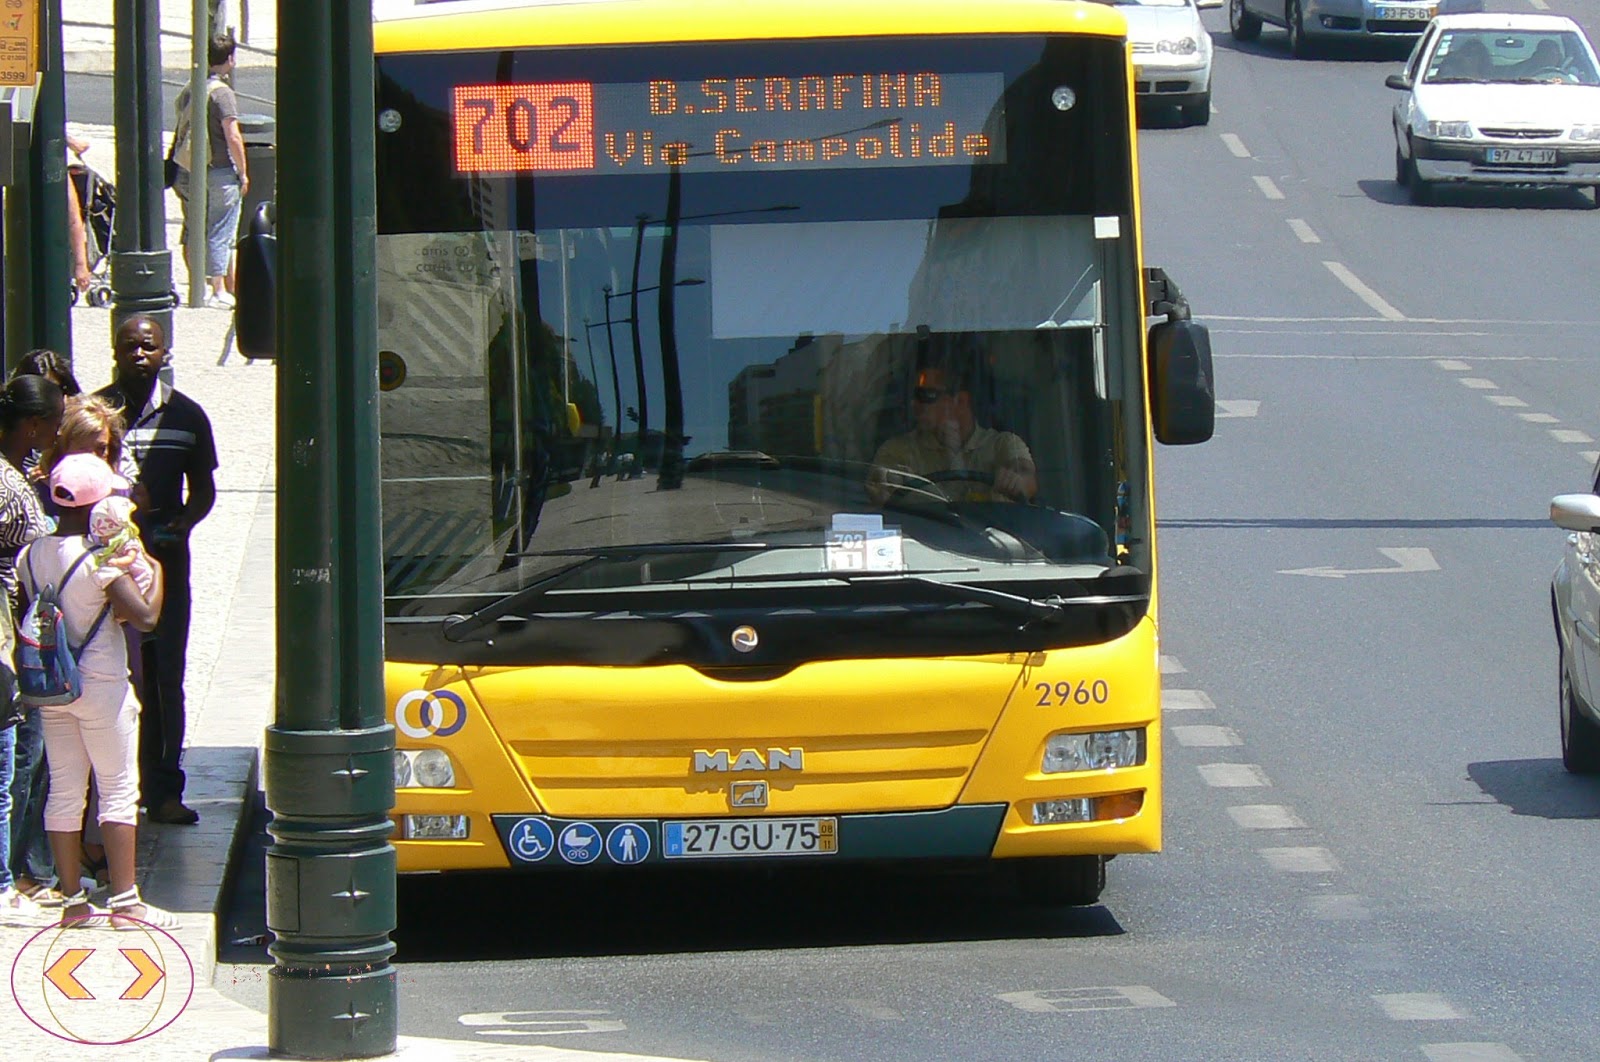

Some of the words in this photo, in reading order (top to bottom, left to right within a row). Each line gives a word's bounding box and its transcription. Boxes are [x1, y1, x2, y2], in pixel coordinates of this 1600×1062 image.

[462, 94, 580, 154] 702
[604, 130, 688, 166] Via
[713, 119, 991, 164] Campolide
[1035, 679, 1109, 707] 2960
[694, 748, 804, 773] MAN
